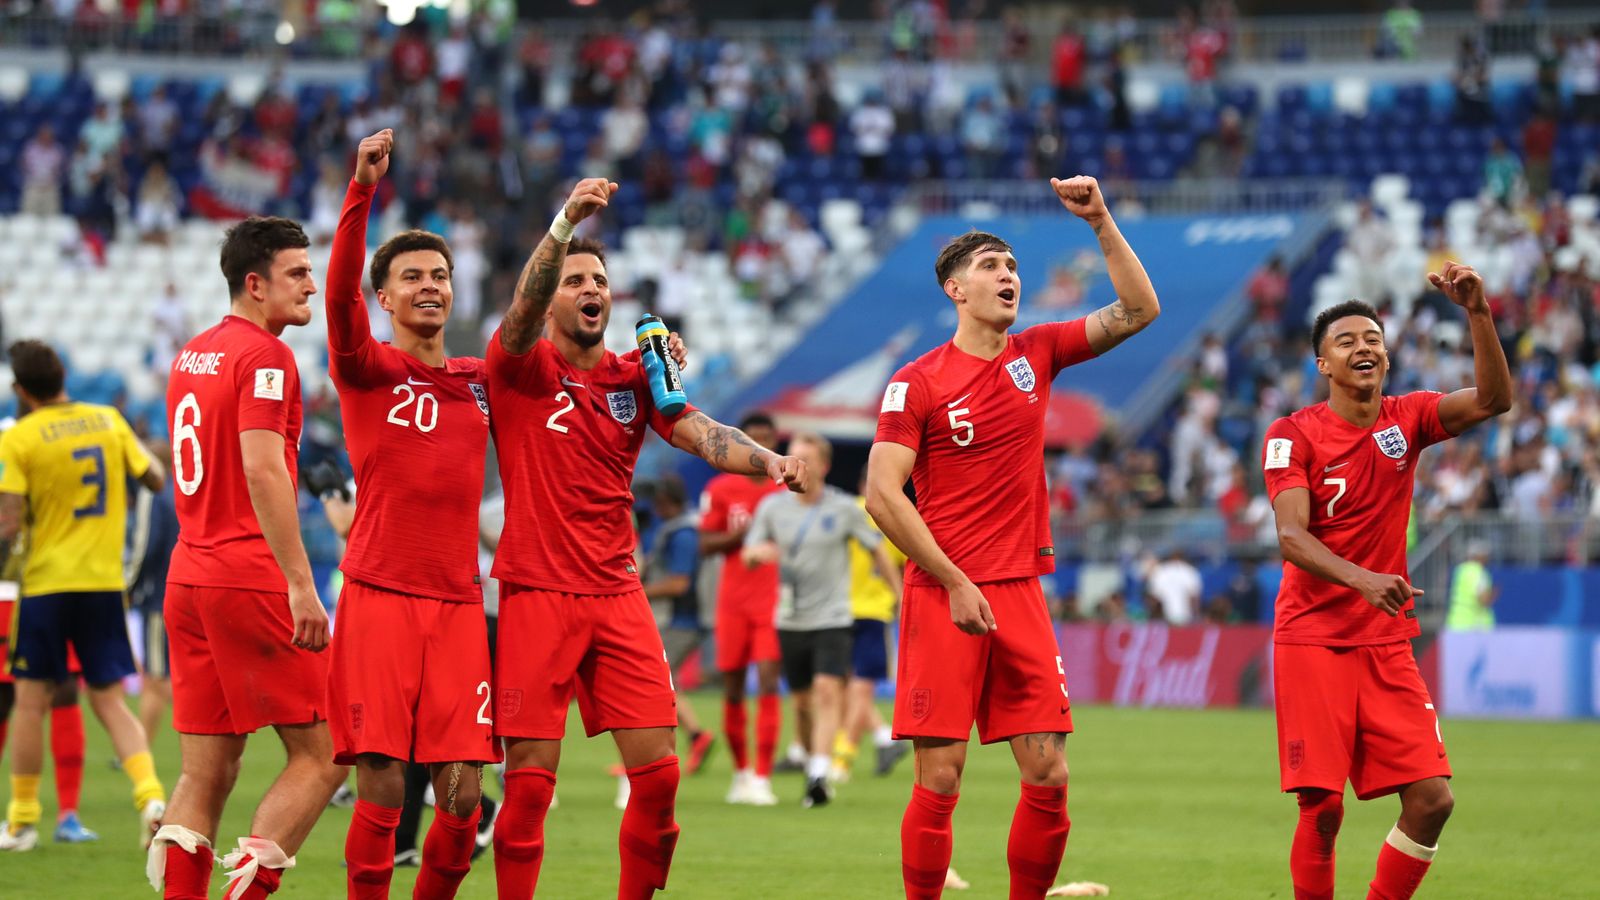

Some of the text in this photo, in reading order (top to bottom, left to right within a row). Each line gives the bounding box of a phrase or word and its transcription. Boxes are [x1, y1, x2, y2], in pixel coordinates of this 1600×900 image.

[175, 350, 225, 375] MAGRE
[387, 384, 438, 433] 20
[546, 391, 575, 434] 2
[948, 408, 974, 447] 5
[173, 392, 204, 496] 6
[72, 446, 107, 519] 3
[1324, 478, 1346, 518] 7
